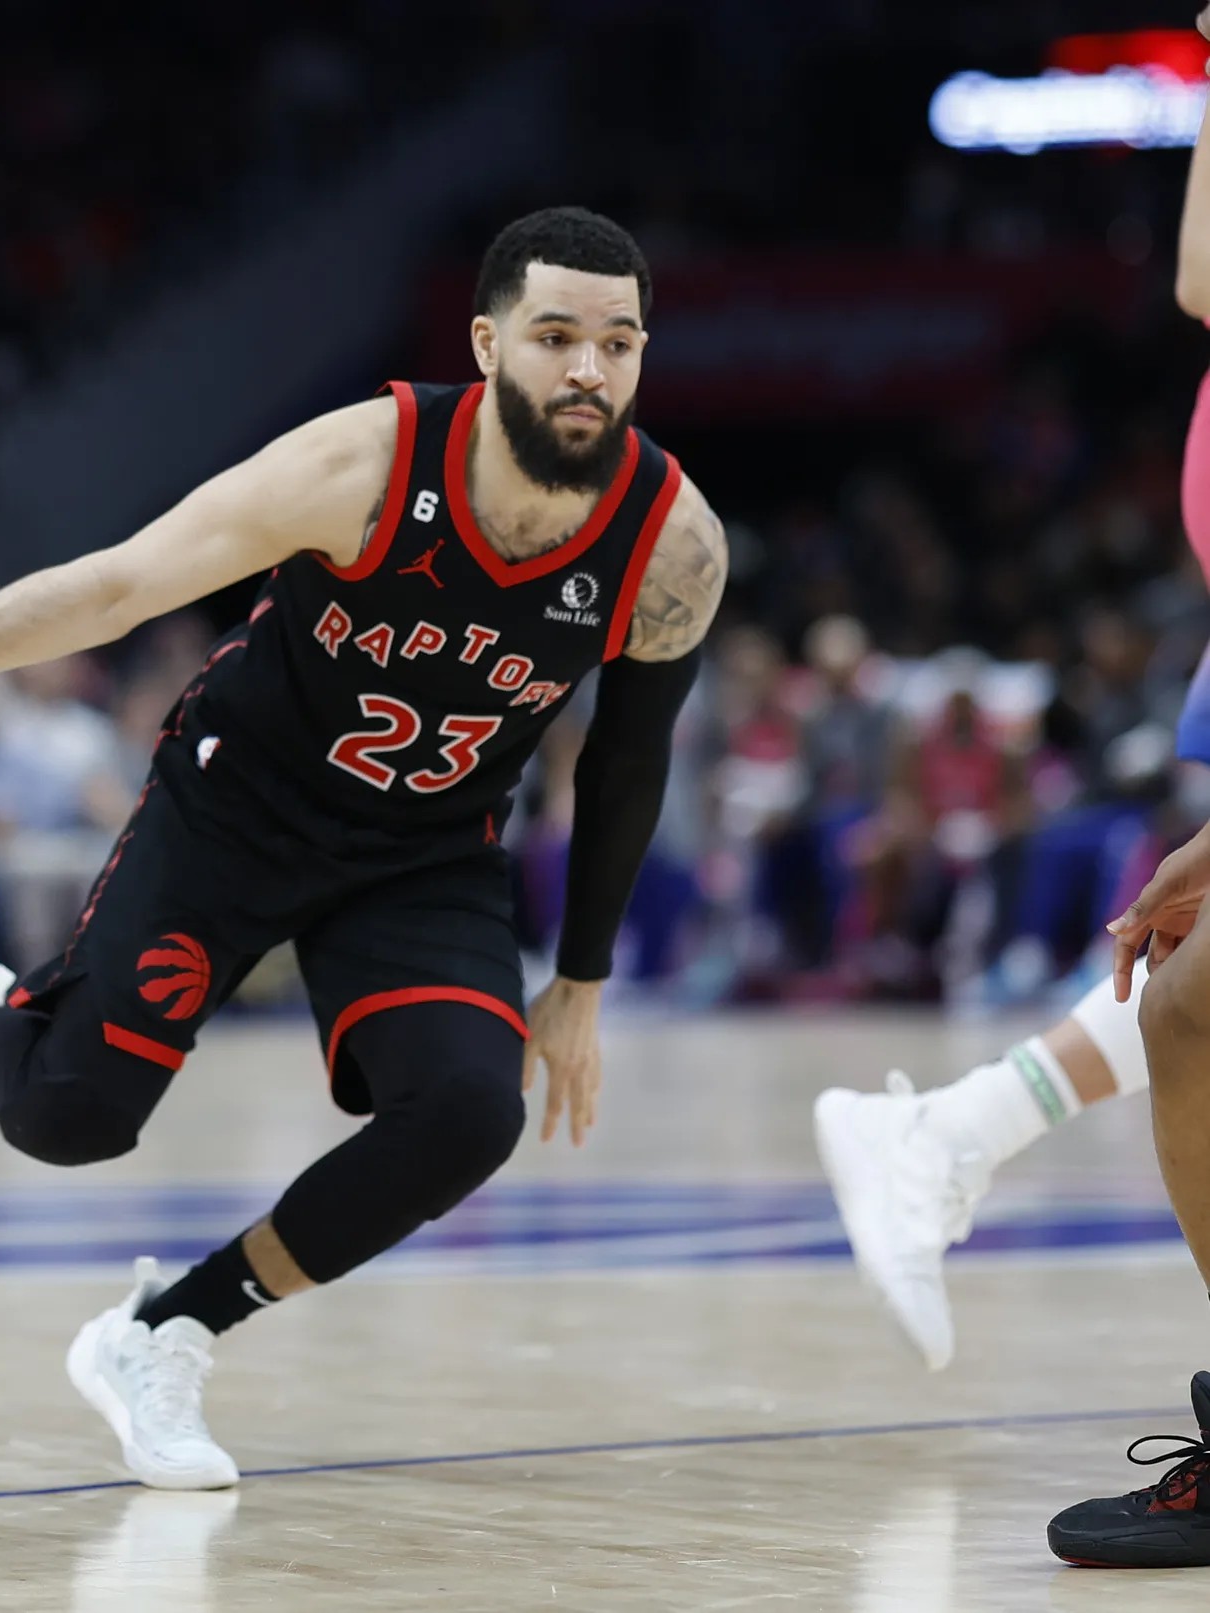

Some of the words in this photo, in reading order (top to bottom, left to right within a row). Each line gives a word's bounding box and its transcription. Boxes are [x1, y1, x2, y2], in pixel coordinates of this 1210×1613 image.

[412, 490, 439, 523] 6
[543, 605, 573, 623] Sun
[573, 611, 601, 627] Life
[326, 694, 504, 794] 23
